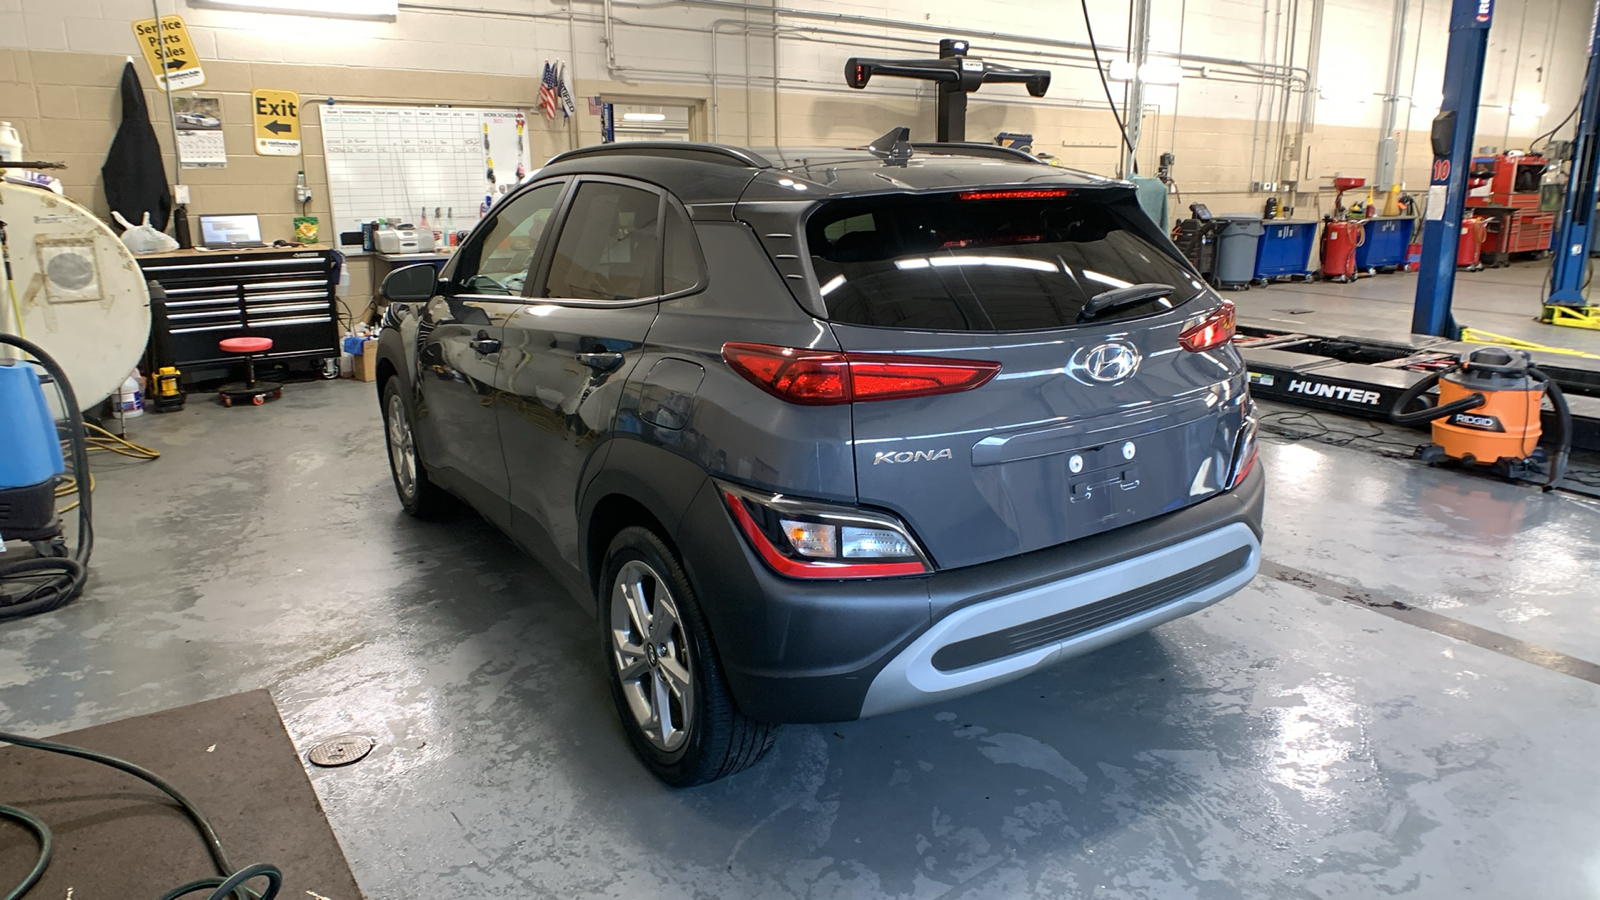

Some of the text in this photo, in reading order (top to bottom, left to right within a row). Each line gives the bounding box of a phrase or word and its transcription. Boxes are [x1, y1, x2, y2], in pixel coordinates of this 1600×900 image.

[255, 97, 297, 117] Exit
[1434, 159, 1451, 181] 10
[1288, 379, 1381, 405] HUNTER
[1456, 414, 1494, 426] RIDGID
[873, 448, 953, 465] KONA
